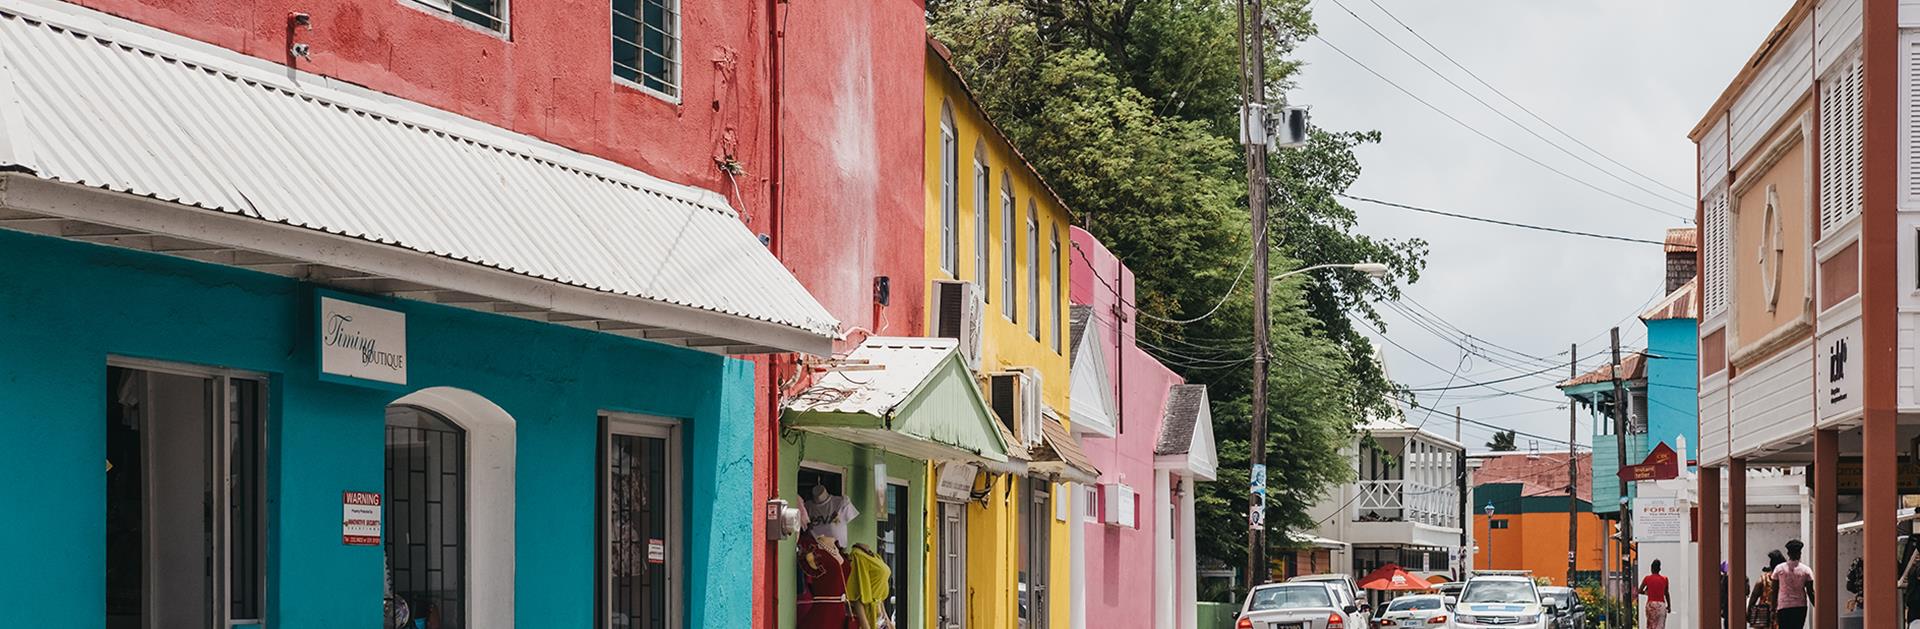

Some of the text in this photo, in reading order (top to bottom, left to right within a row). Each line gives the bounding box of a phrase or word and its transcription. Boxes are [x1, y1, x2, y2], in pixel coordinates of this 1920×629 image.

[325, 312, 376, 367] Timing
[362, 346, 403, 371] BOUTIQUE
[346, 492, 380, 505] WARNING
